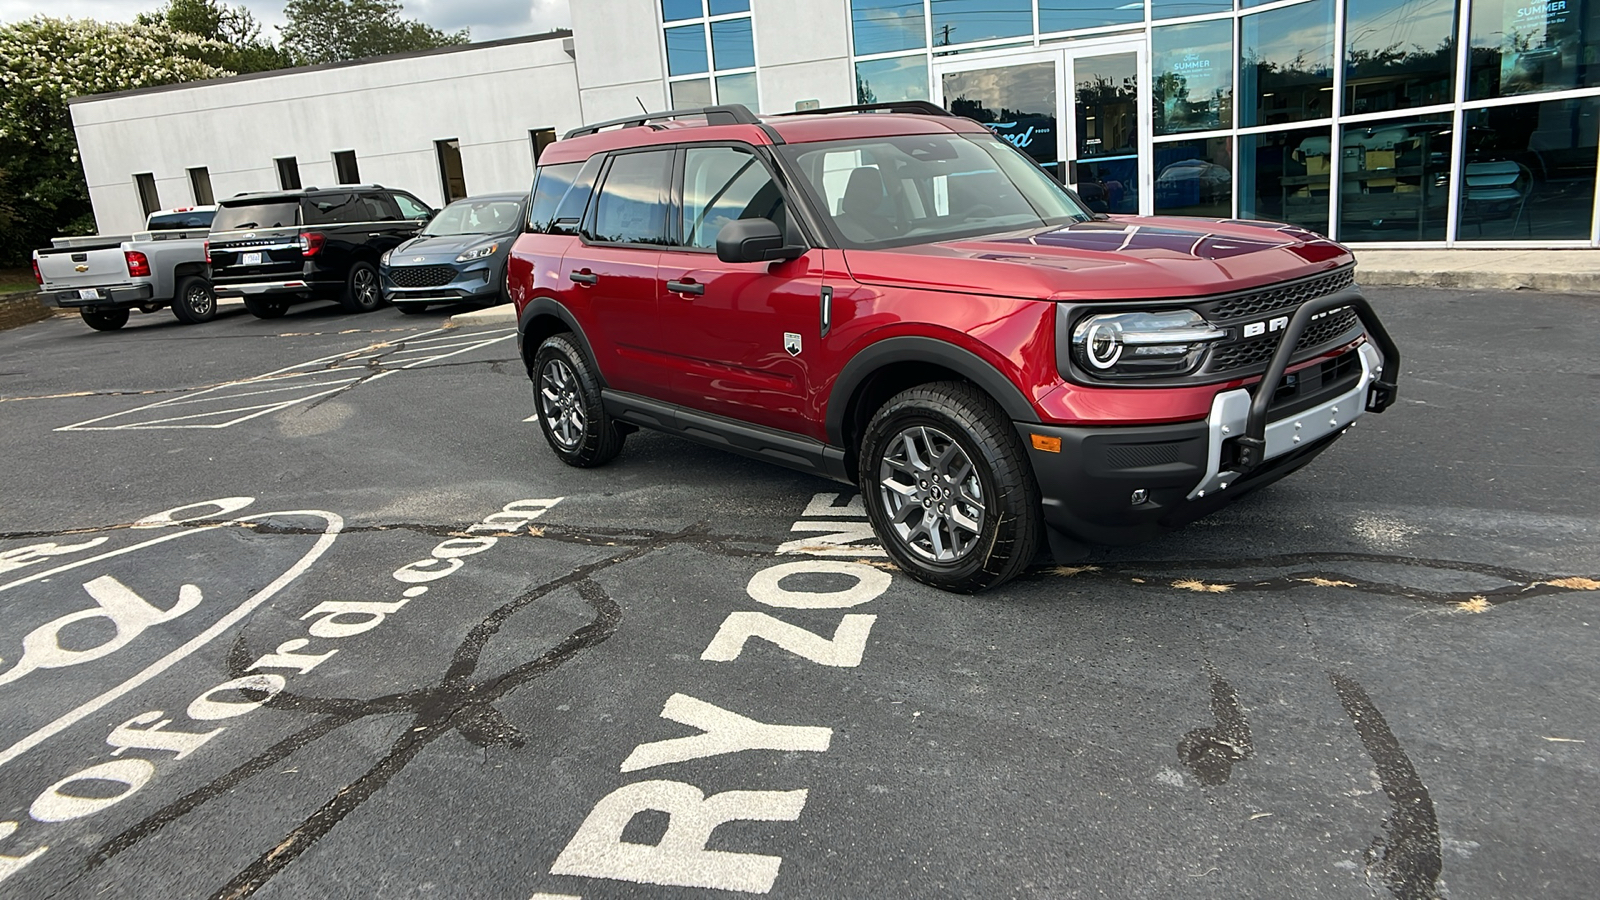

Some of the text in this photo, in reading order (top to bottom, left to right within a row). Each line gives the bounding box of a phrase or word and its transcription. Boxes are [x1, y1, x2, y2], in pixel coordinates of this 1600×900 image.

[1517, 1, 1566, 17] SUMMER
[1174, 60, 1210, 70] SUMMER
[530, 693, 833, 900] RY
